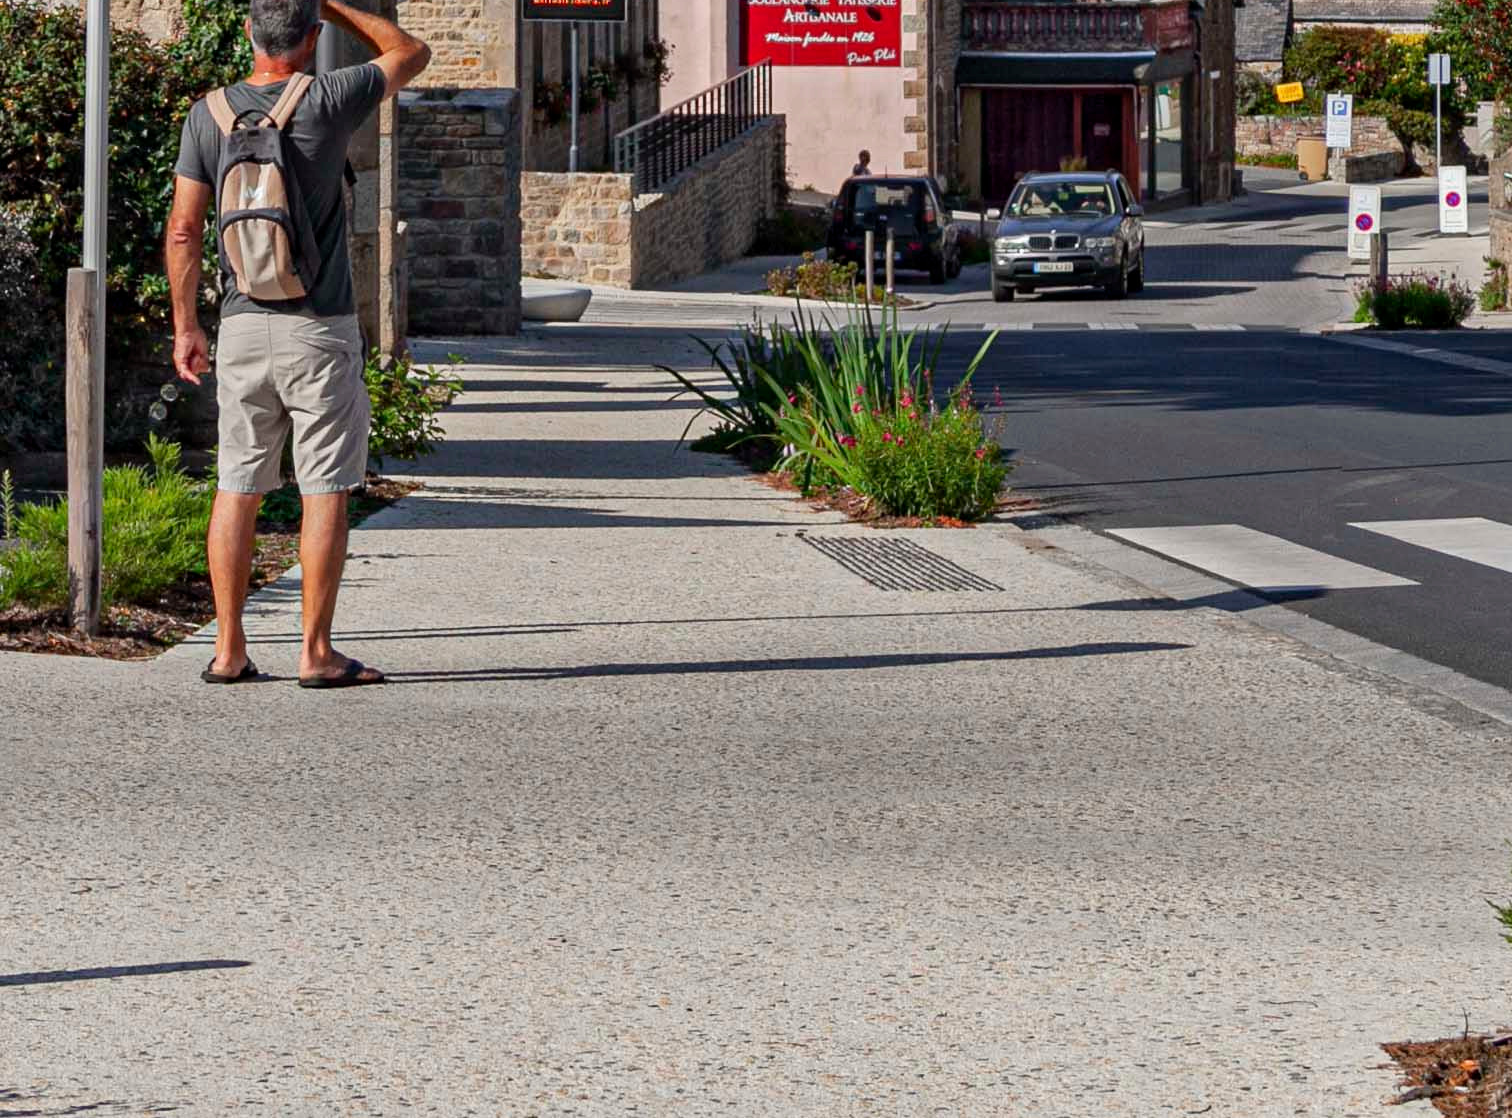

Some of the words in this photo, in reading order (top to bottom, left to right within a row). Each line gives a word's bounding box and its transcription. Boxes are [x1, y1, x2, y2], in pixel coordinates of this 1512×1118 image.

[765, 32, 802, 43] Maison
[802, 31, 835, 48] fondée
[836, 35, 850, 43] en
[851, 31, 875, 43] 1926
[846, 51, 872, 66] Pain
